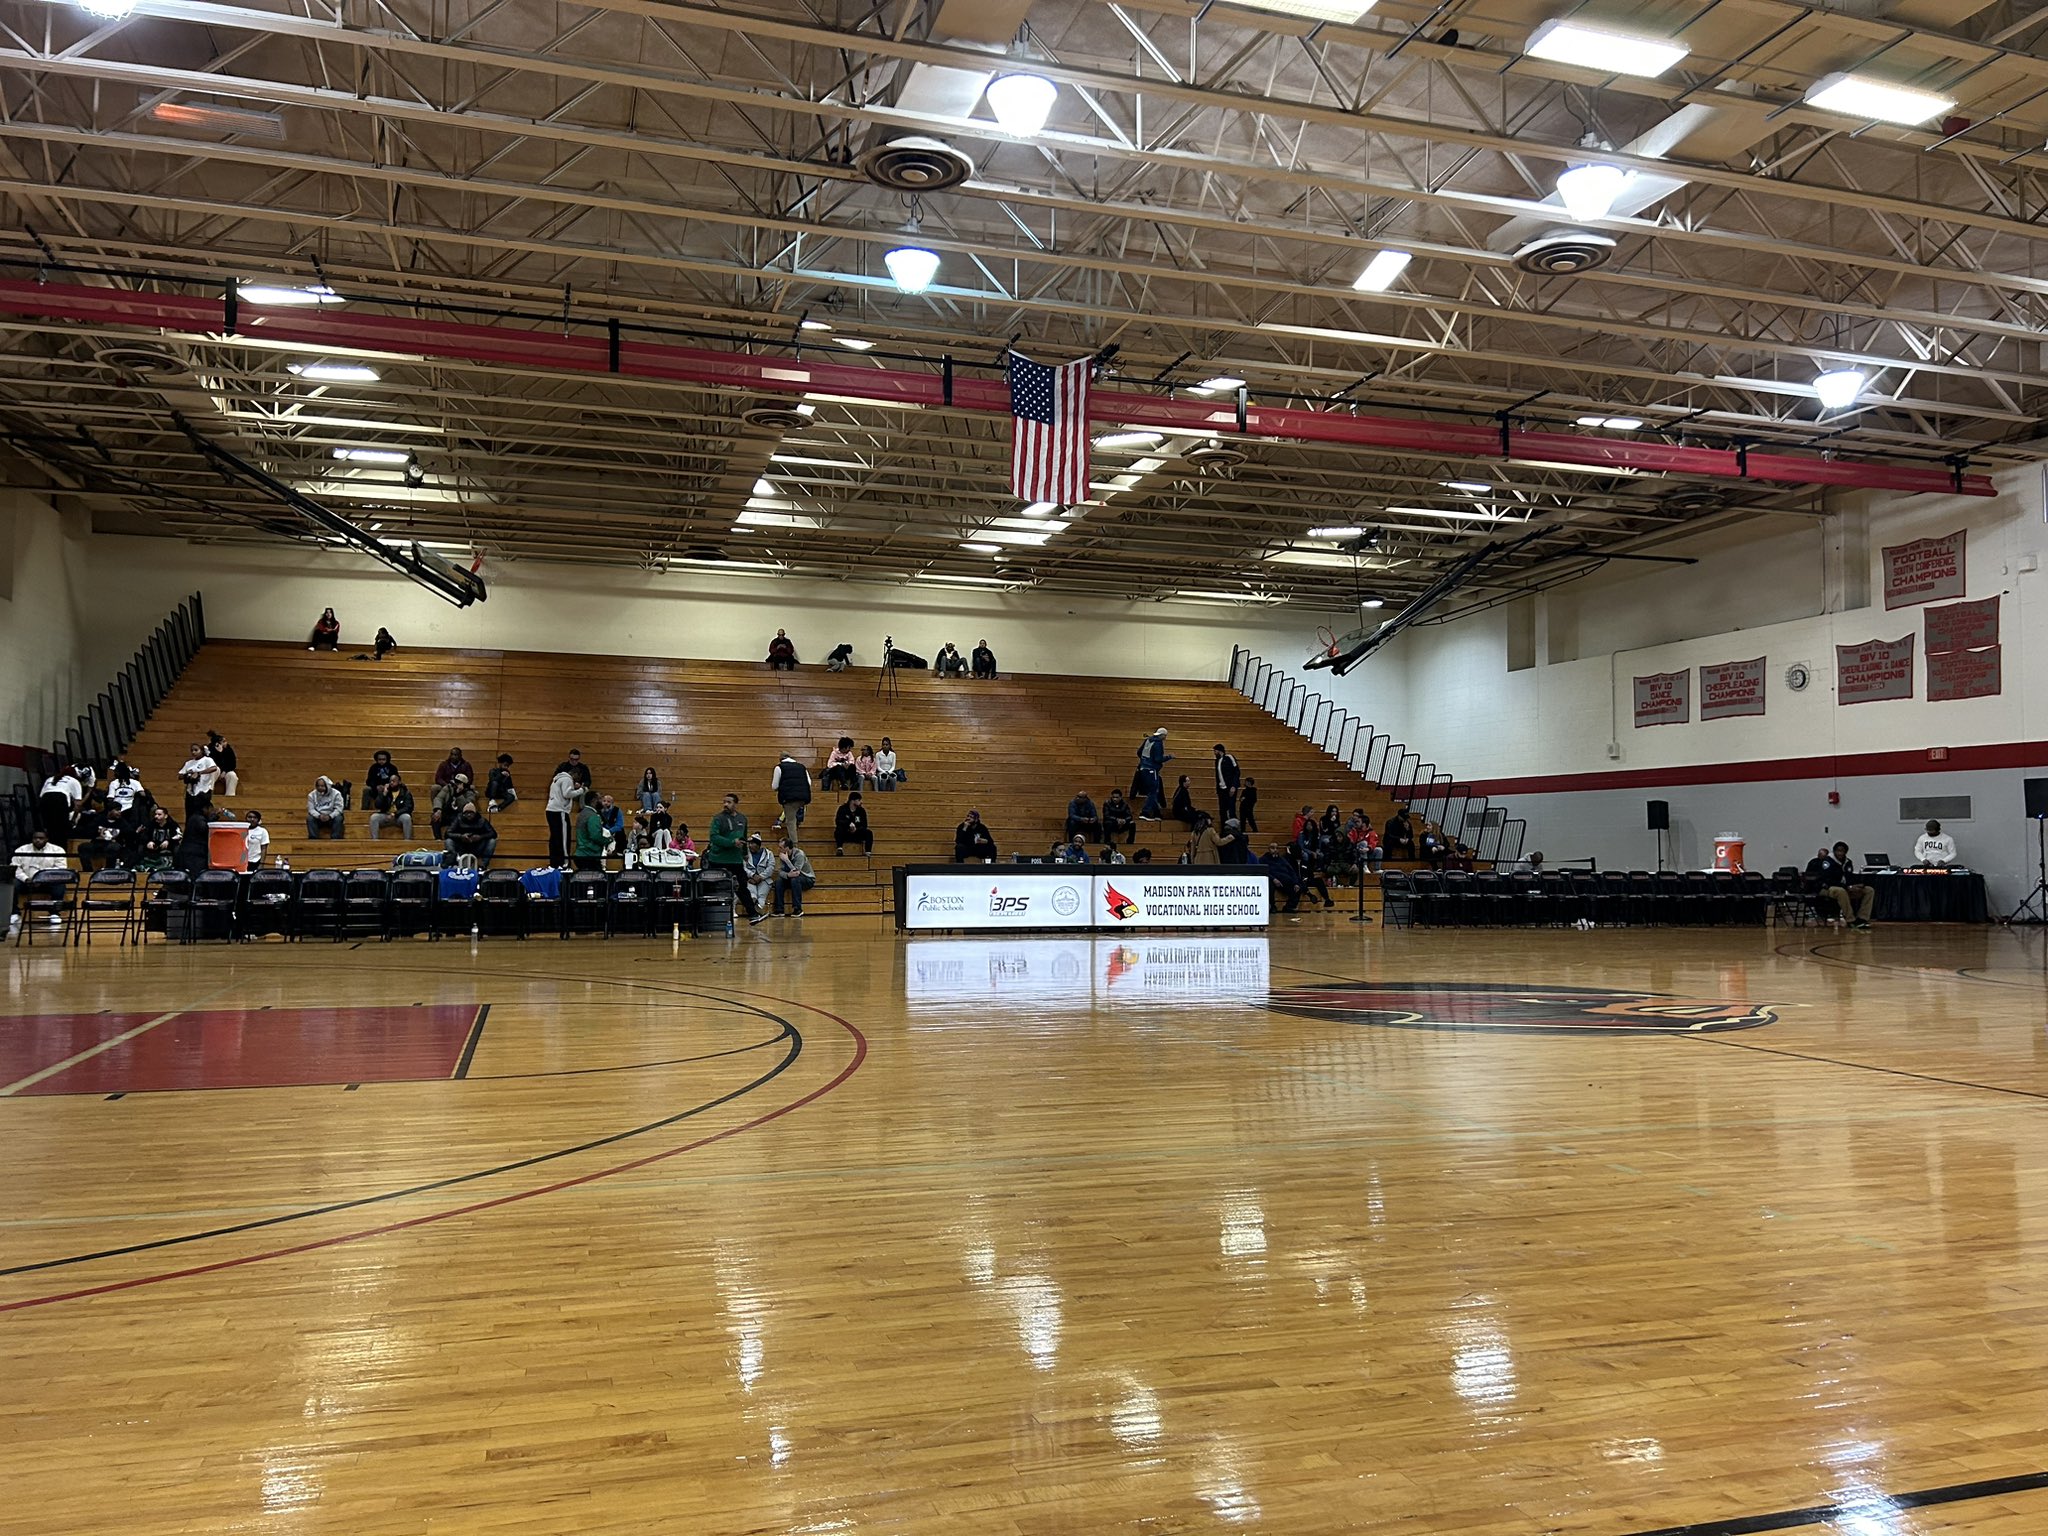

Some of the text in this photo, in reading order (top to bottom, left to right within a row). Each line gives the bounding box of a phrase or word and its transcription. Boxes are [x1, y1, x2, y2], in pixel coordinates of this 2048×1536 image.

[1893, 546, 1955, 566] FOOTBALL
[1893, 555, 1956, 576] SOUTH CONFERENCE
[1892, 566, 1957, 587] CHAMPIONS
[1878, 651, 1889, 660] 10
[1841, 662, 1884, 675] CHEERLEADING
[1890, 657, 1910, 669] DANCE
[1735, 671, 1745, 680] 10
[1845, 670, 1905, 684] CHAMPIONS
[1664, 682, 1673, 690] 10
[1705, 678, 1760, 692] CHEERLEADING
[1650, 691, 1672, 700] DANCE
[1709, 688, 1756, 700] CHAMPIONS
[1641, 698, 1683, 709] CHAMPIONS
[1931, 750, 1943, 760] EXIT
[1716, 845, 1726, 858] G
[1924, 841, 1943, 850] POLO
[1143, 885, 1262, 898] MADISON PARK TECHNICAL
[930, 896, 964, 904] BOSTON
[990, 897, 1030, 912] BPS
[922, 904, 965, 912] Public Schools
[1146, 904, 1260, 916] VOCATIONAL HIGH SCHOOL
